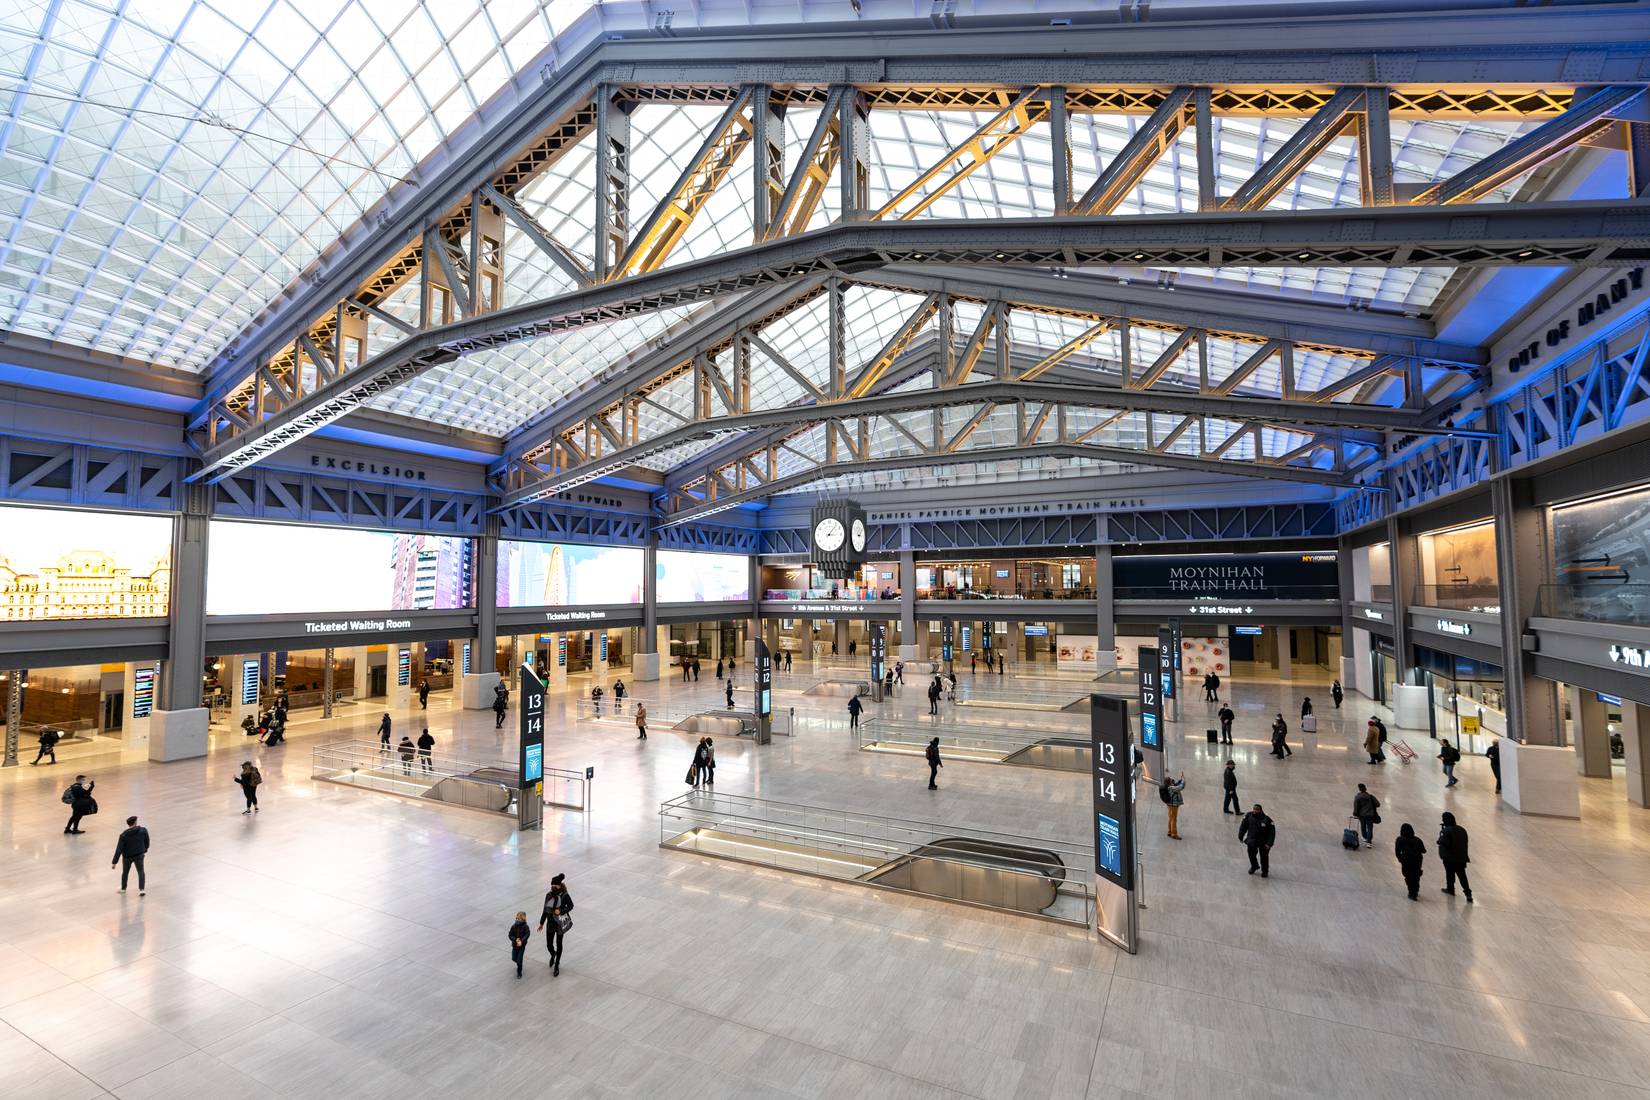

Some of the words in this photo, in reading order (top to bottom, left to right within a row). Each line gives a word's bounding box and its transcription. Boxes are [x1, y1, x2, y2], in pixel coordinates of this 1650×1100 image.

[1509, 341, 1540, 373] OUT
[1546, 319, 1570, 347] OF
[1578, 267, 1644, 327] MANY
[311, 455, 426, 480] EXCELSIOR
[578, 494, 623, 508] UPWARD
[871, 511, 912, 521] DANIEL
[919, 508, 972, 519] PATRICK
[979, 504, 1049, 515] MOYNIHAN
[1057, 501, 1101, 512] TRAIN
[1109, 498, 1146, 509] HALL
[1170, 566, 1264, 579] MOYNIHAN
[1169, 579, 1219, 591] TRAIN
[1223, 578, 1268, 591] HALL
[546, 612, 570, 620] Ticketed
[571, 611, 590, 620] Waiting
[1199, 606, 1217, 614] 31st
[1217, 606, 1243, 614] Street
[305, 621, 348, 632] Ticketed
[350, 620, 384, 631] Waiting
[386, 619, 411, 629] Room
[1162, 645, 1168, 654] 9
[763, 657, 770, 668] 11
[1622, 646, 1642, 667] 9th
[1162, 659, 1170, 668] 10
[763, 672, 770, 684] 12
[1144, 672, 1153, 685] 11
[528, 693, 541, 709] 13
[1143, 692, 1154, 705] 12
[527, 717, 541, 734] 14
[1099, 741, 1115, 765] 13
[1099, 777, 1117, 802] 14
